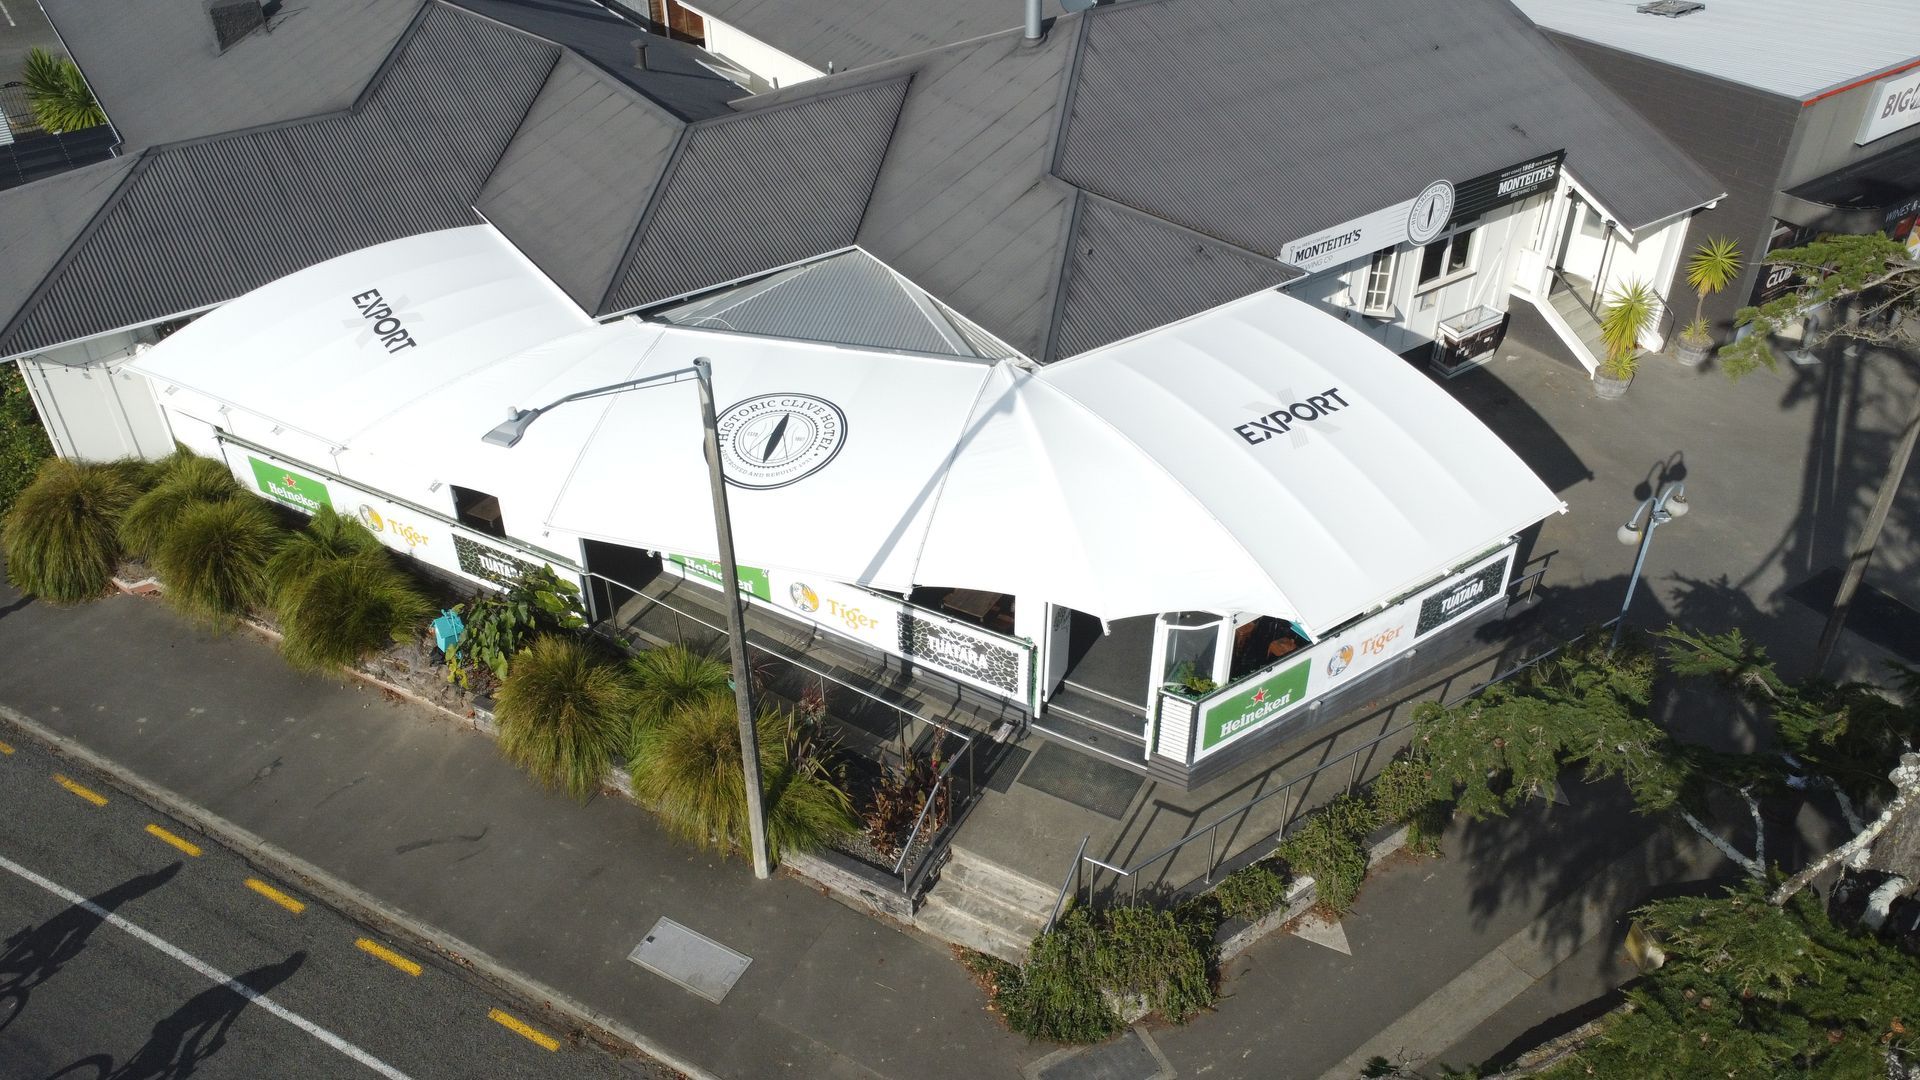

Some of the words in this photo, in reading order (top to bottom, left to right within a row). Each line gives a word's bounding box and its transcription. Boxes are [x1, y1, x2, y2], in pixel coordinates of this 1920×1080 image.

[1881, 88, 1913, 119] BIG
[1498, 164, 1556, 195] MONTEITH'S
[1294, 229, 1362, 263] MONTEITH'S
[352, 288, 417, 354] EXPORT
[719, 400, 776, 441] HISTORIC
[781, 399, 825, 416] CLIVE
[819, 413, 836, 450] HOTEL
[1233, 387, 1349, 445] EXPORT
[765, 466, 798, 478] REBUILT
[267, 481, 321, 510] Heineken
[387, 518, 429, 547] Tiger
[684, 557, 753, 593] Heineen
[1442, 580, 1483, 613] TUATARA
[826, 598, 879, 631] Tiger
[927, 634, 989, 670] TUATARA
[1360, 624, 1404, 655] Tiger
[1220, 691, 1291, 738] Heineken
